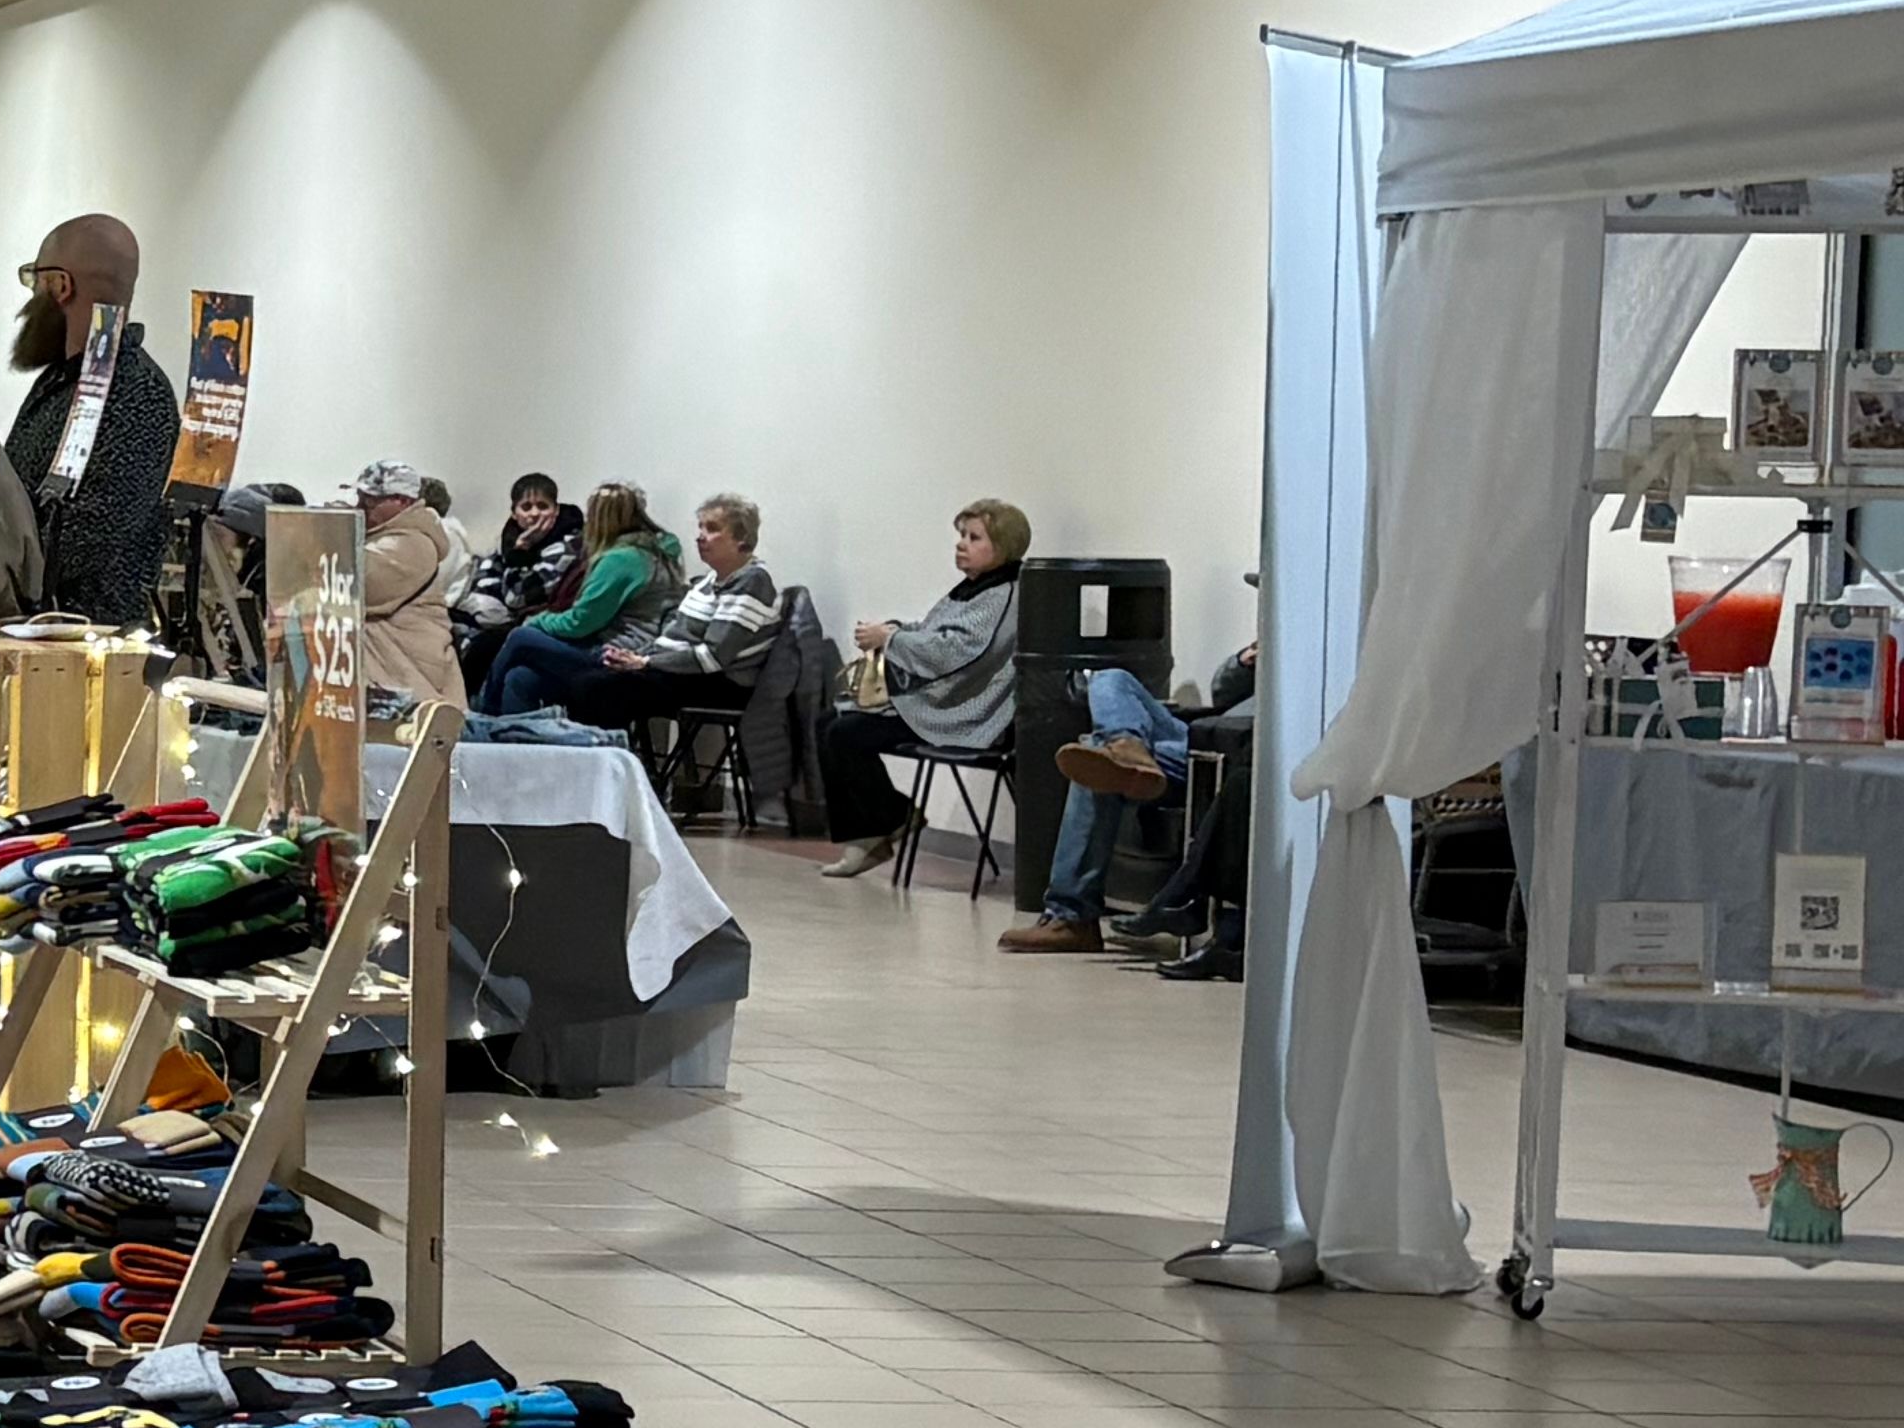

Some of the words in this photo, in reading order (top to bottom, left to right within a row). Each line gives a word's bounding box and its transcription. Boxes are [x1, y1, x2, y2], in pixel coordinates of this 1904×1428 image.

[318, 553, 330, 604] 3
[330, 551, 355, 606] for
[313, 604, 355, 693] $25
